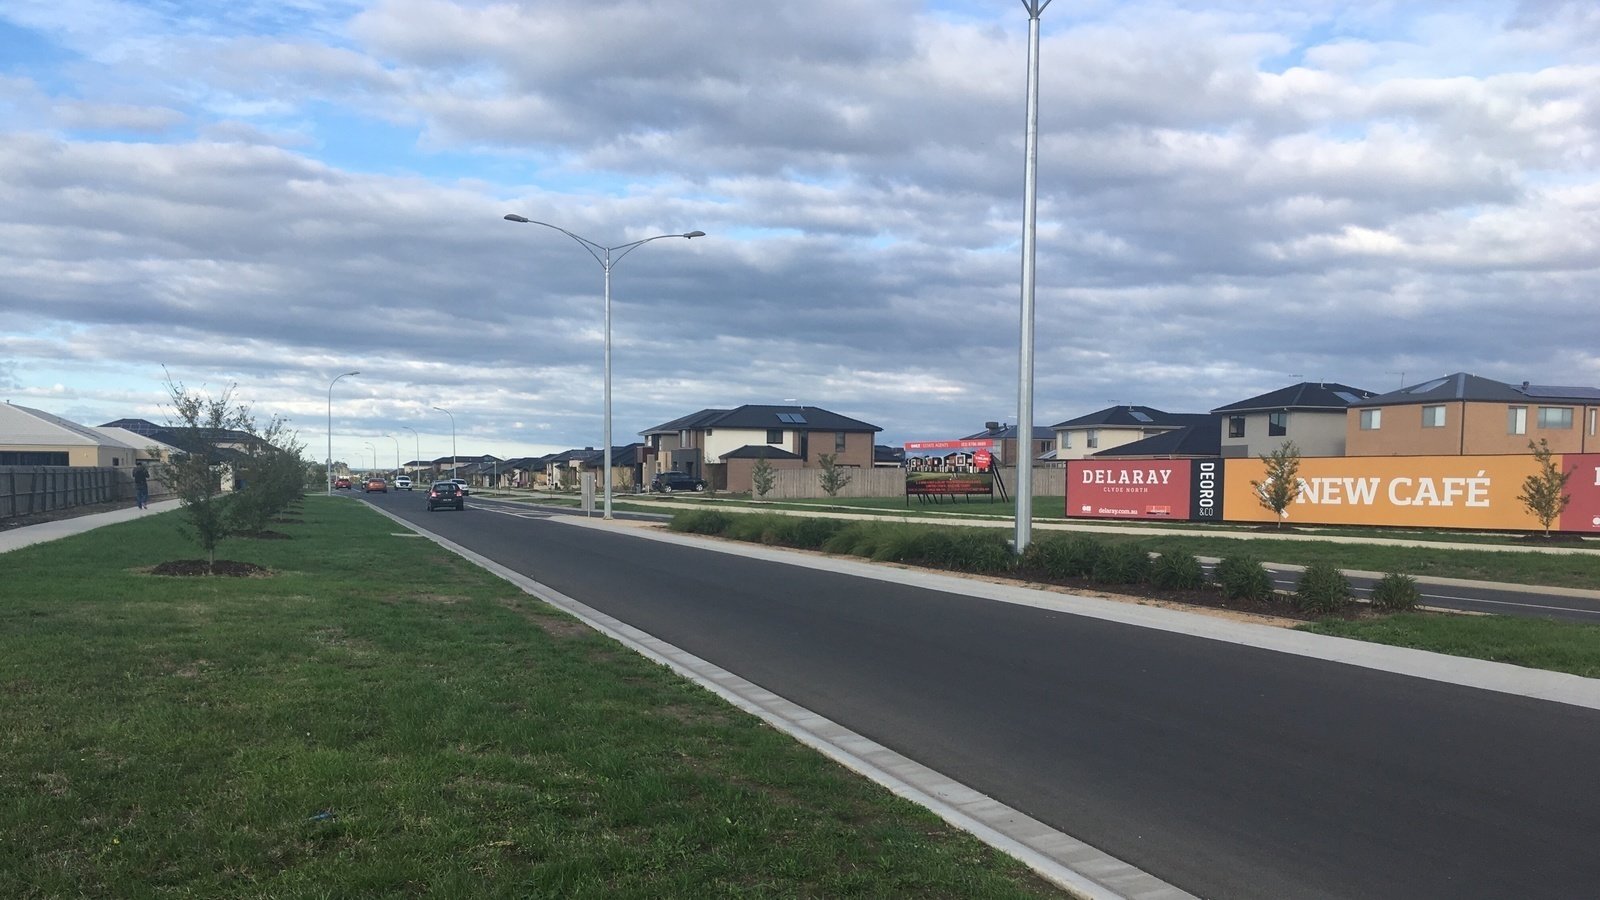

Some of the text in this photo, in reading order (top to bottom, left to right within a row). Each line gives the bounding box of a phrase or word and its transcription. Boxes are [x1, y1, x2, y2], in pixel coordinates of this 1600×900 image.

[1082, 469, 1172, 484] DELARAY
[1199, 462, 1215, 507] DEORO
[1295, 470, 1491, 507] NEW CAFÉ
[1098, 507, 1138, 515] delaray.com.au
[1199, 507, 1214, 516] &CO
